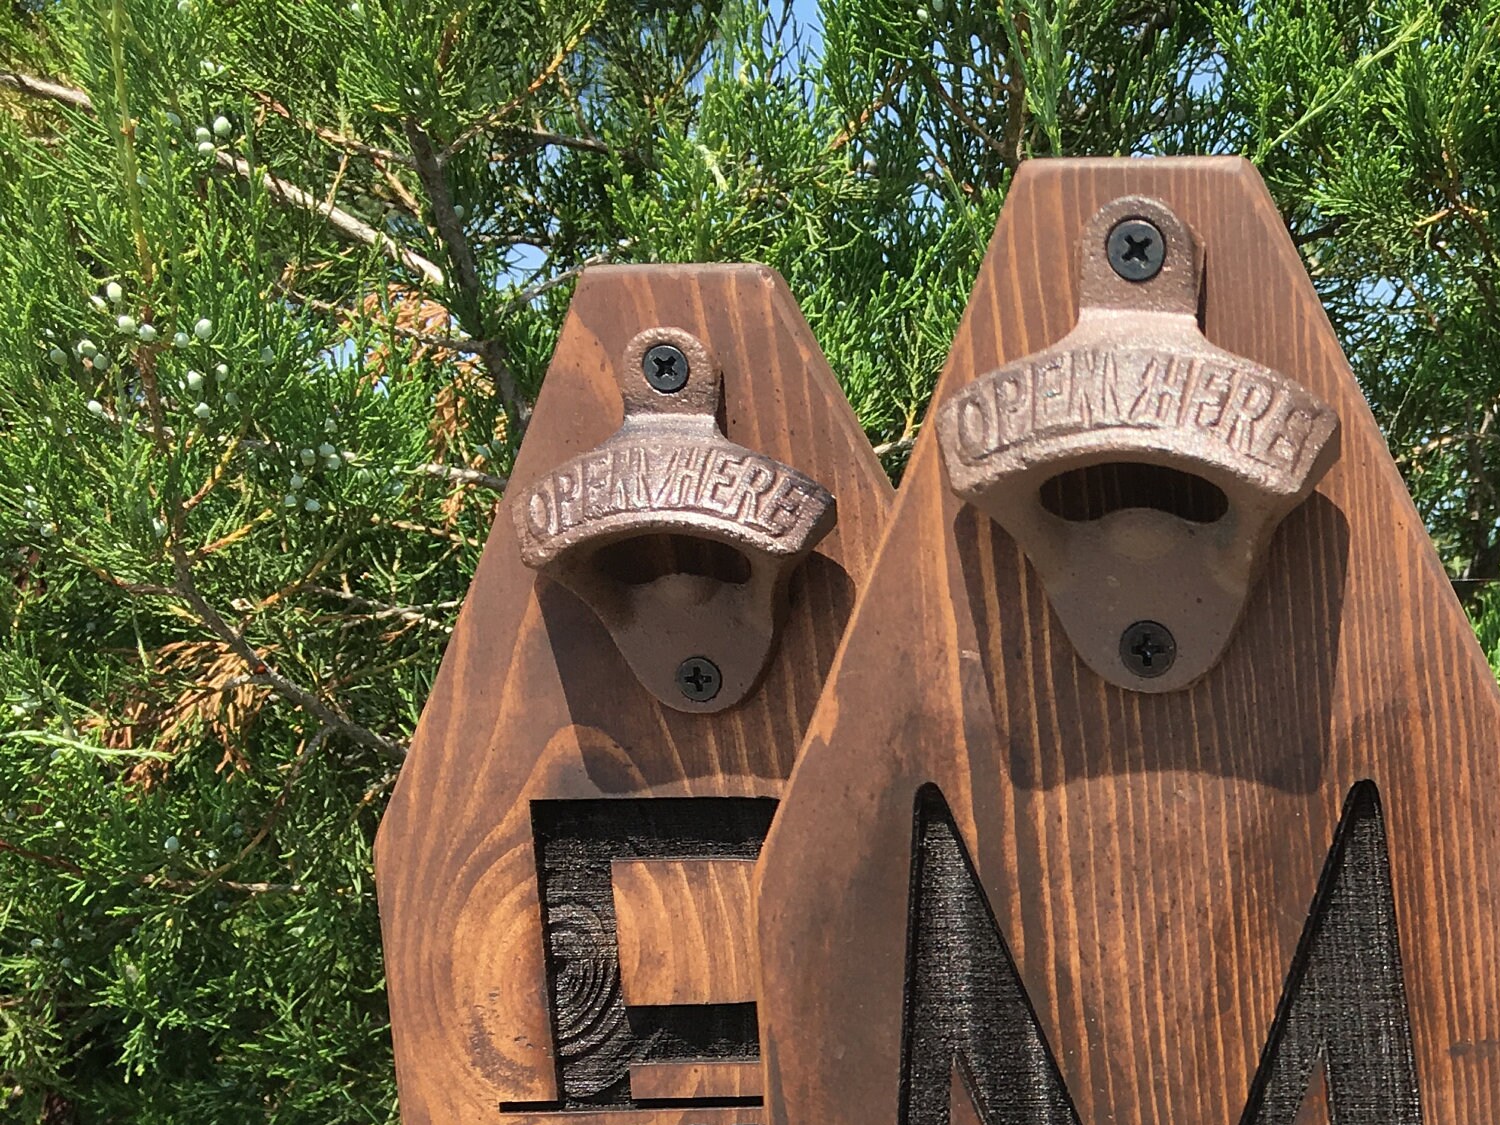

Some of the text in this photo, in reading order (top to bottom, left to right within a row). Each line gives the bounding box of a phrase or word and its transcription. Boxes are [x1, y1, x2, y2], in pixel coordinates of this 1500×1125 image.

[957, 350, 1319, 475] OPEN HERE
[527, 447, 811, 540] OPEN HERE
